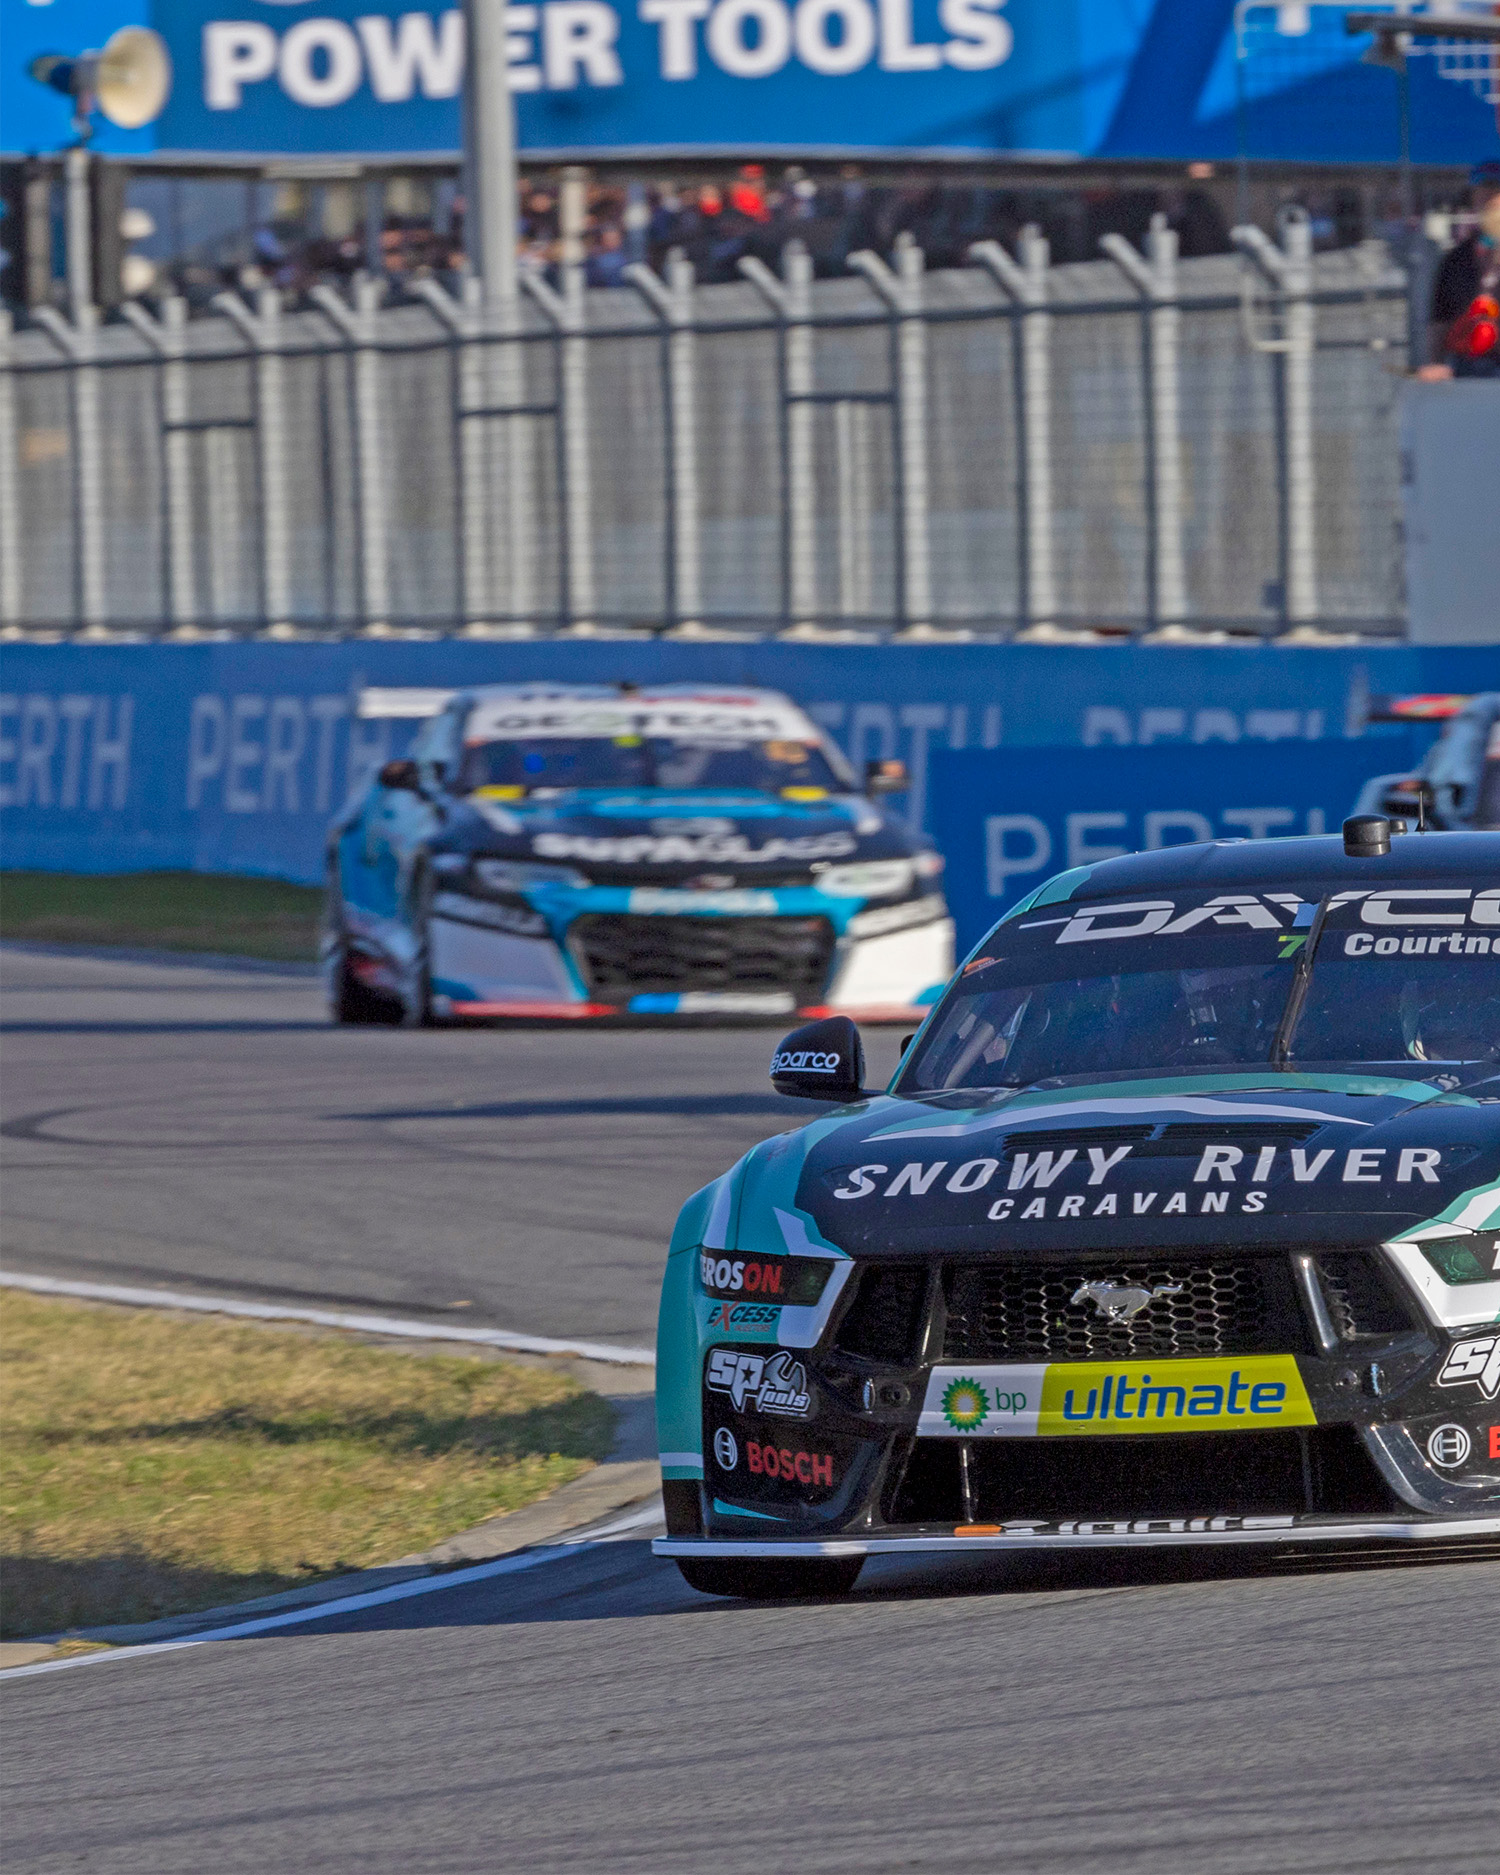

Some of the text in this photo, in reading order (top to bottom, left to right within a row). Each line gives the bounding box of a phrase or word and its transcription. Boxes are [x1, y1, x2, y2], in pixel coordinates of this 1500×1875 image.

[641, 0, 1013, 80] TOOLS
[0, 695, 133, 810] ERTH
[769, 1050, 841, 1076] sparco
[834, 1146, 1442, 1200] SNOWY RIVER
[987, 1190, 1268, 1221] CARAVANS
[707, 1301, 782, 1332] EXCESS
[756, 1379, 811, 1412] tools
[995, 1370, 1288, 1421] bp ultimate
[745, 1440, 833, 1488] BOSCH
